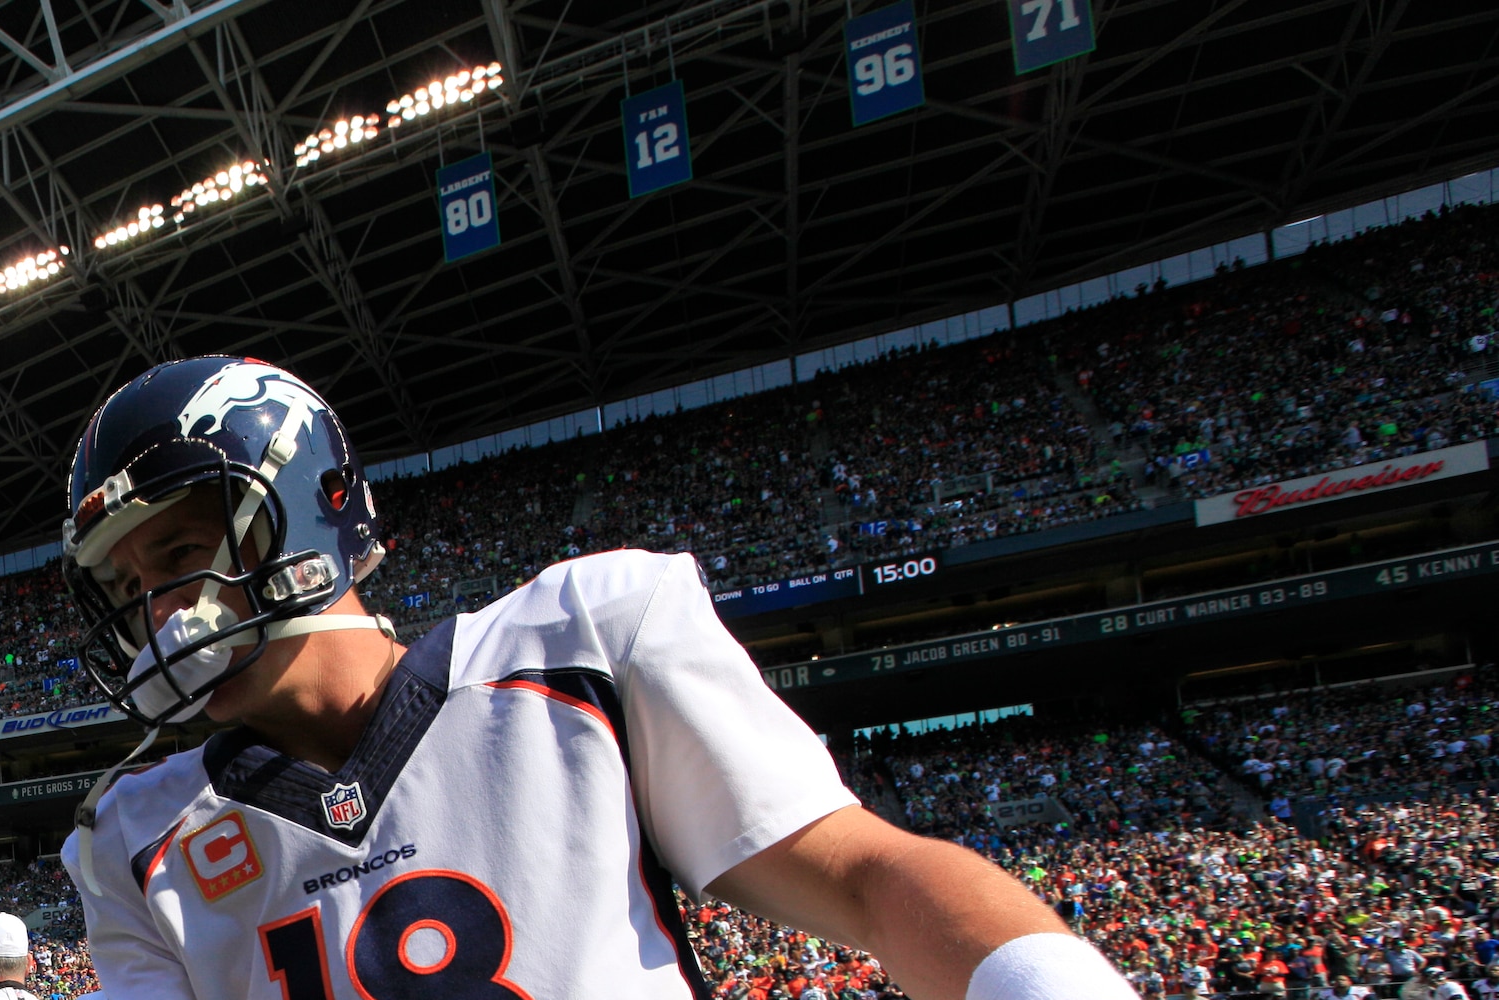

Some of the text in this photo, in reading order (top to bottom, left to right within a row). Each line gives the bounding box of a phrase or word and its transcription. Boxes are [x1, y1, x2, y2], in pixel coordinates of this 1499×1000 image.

[850, 22, 911, 51] KENNEDY
[1021, 0, 1080, 43] 71
[854, 43, 915, 96] 96
[639, 105, 668, 124] FAN
[635, 122, 680, 170] 12
[440, 169, 491, 197] LARGENT
[446, 190, 492, 236] 80
[1234, 460, 1444, 518] Budweiser
[714, 568, 854, 603] DOWN TO GO BALL ON QTR
[873, 557, 936, 585] 15:00
[1375, 566, 1408, 585] 45
[1417, 554, 1481, 578] KENNY
[1100, 615, 1128, 634] 28
[1135, 606, 1176, 627] CURT
[1184, 594, 1252, 618] WARNER
[871, 654, 896, 672] 79
[903, 645, 947, 666] JACOB
[953, 637, 999, 657] GREEN
[2, 706, 111, 734] BUD LIGHT
[22, 777, 101, 797] PETE GROSS 76-
[330, 801, 361, 822] NFL
[998, 802, 1044, 818] 210
[189, 819, 249, 880] C
[303, 843, 417, 895] BRONCOS
